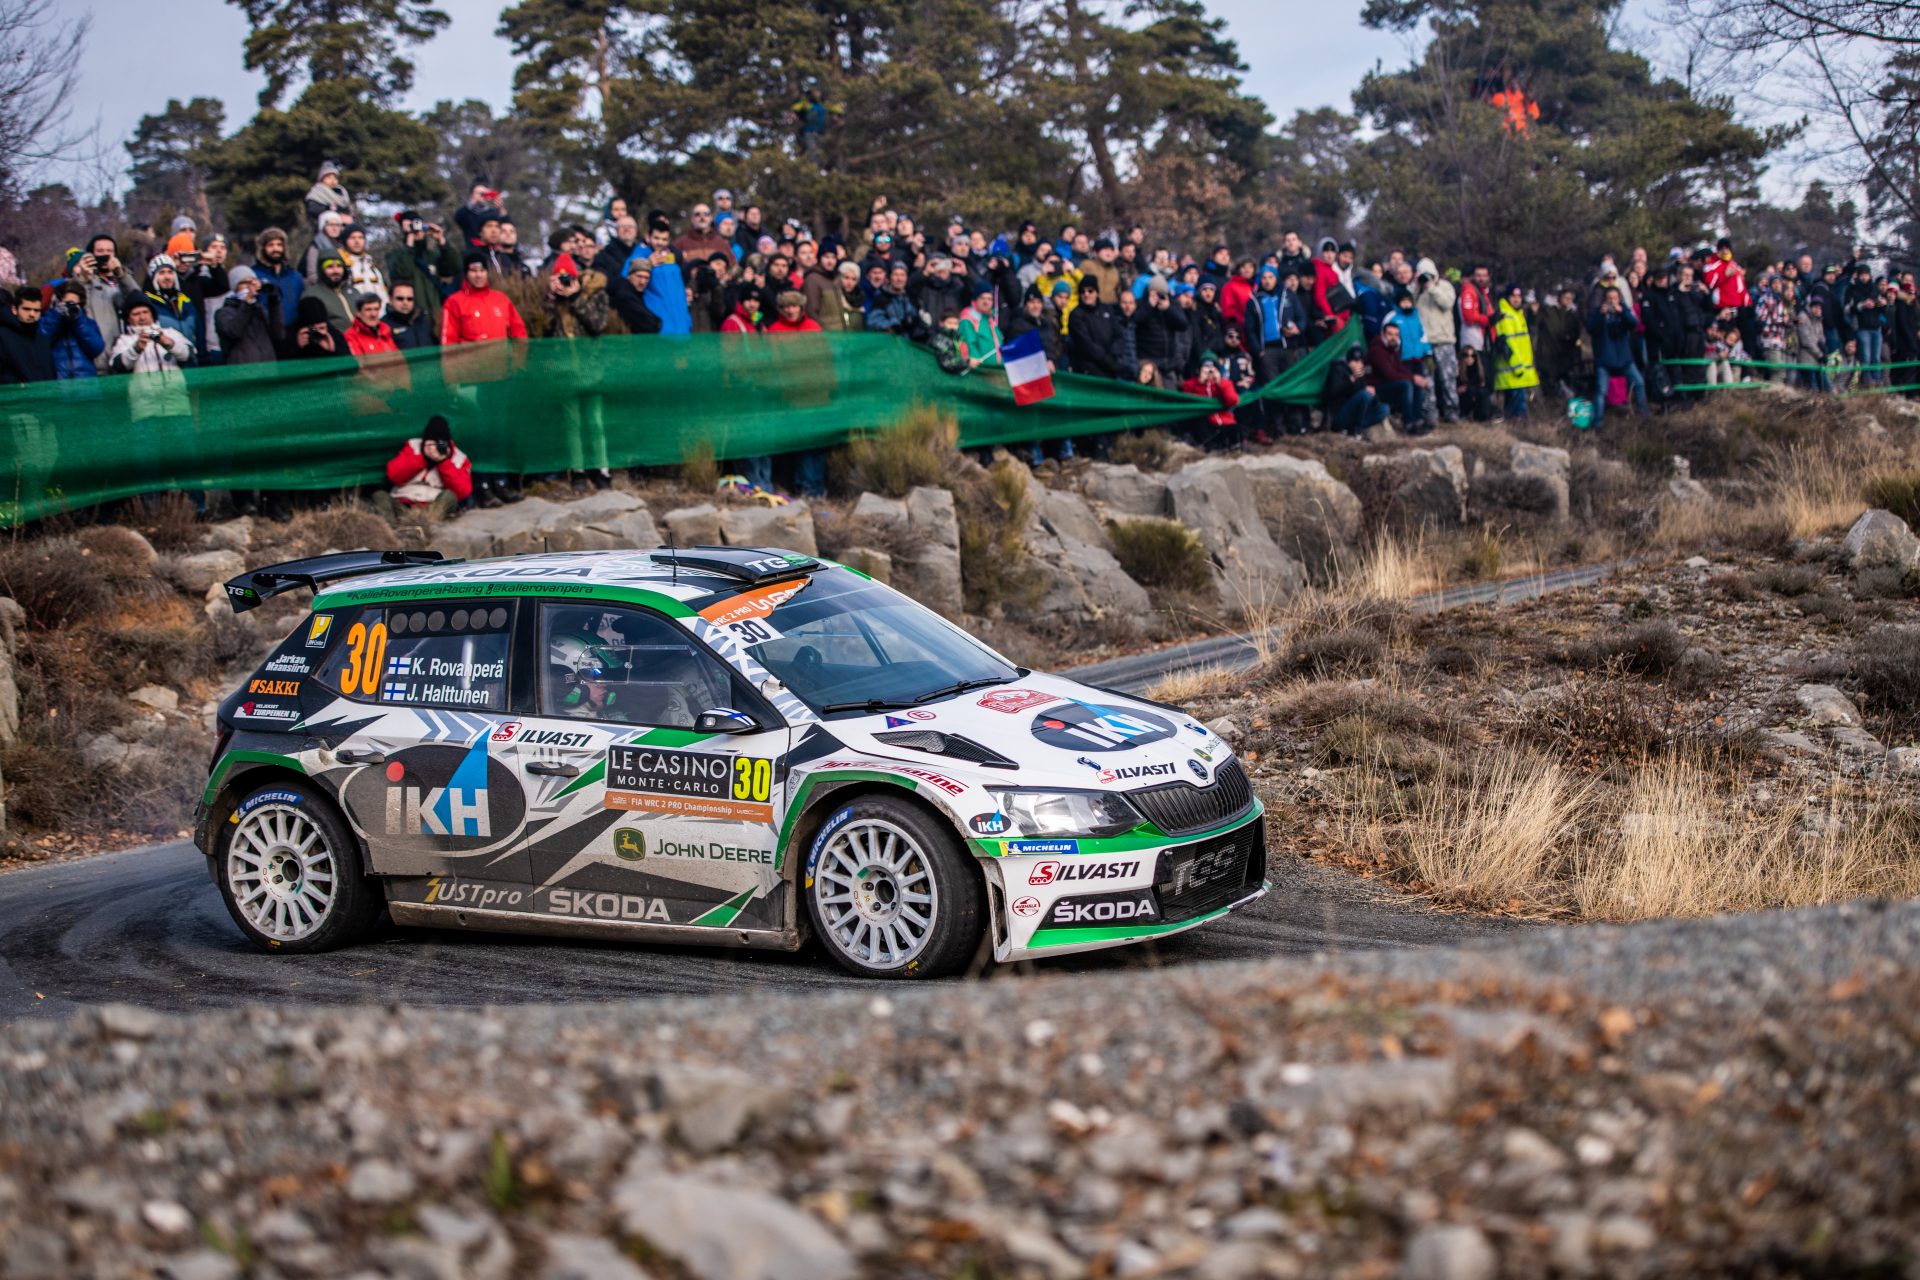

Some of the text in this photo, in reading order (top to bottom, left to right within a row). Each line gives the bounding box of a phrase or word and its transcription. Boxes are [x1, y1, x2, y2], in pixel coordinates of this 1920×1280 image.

[710, 613, 731, 627] WRC
[729, 612, 737, 620] 2
[735, 605, 752, 617] PRO
[728, 619, 772, 644] 30
[265, 661, 310, 674] Maansiirto
[276, 654, 306, 665] Jarkan
[340, 622, 388, 695] 30
[411, 657, 504, 682] K. Rovanperä
[258, 680, 301, 696] SAKKI
[406, 684, 490, 705] J. Halttunen
[253, 708, 290, 718] TURPEINEN
[503, 723, 593, 748] SILVASTI
[611, 750, 728, 779] LE CASINO
[1102, 762, 1177, 782] SILVASTI
[733, 757, 771, 802] 30
[246, 792, 297, 809] MICHELIN
[631, 797, 643, 806] FIA
[644, 799, 660, 808] WRC
[661, 800, 667, 808] 2
[668, 801, 682, 810] PRO
[684, 802, 733, 815] Championship
[810, 809, 849, 863] MICHELIN
[653, 839, 773, 864] JOHN DEERE
[1022, 844, 1072, 852] MICHELIN
[1040, 861, 1141, 882] SILVASTI
[1054, 899, 1155, 924] ŠKODA
